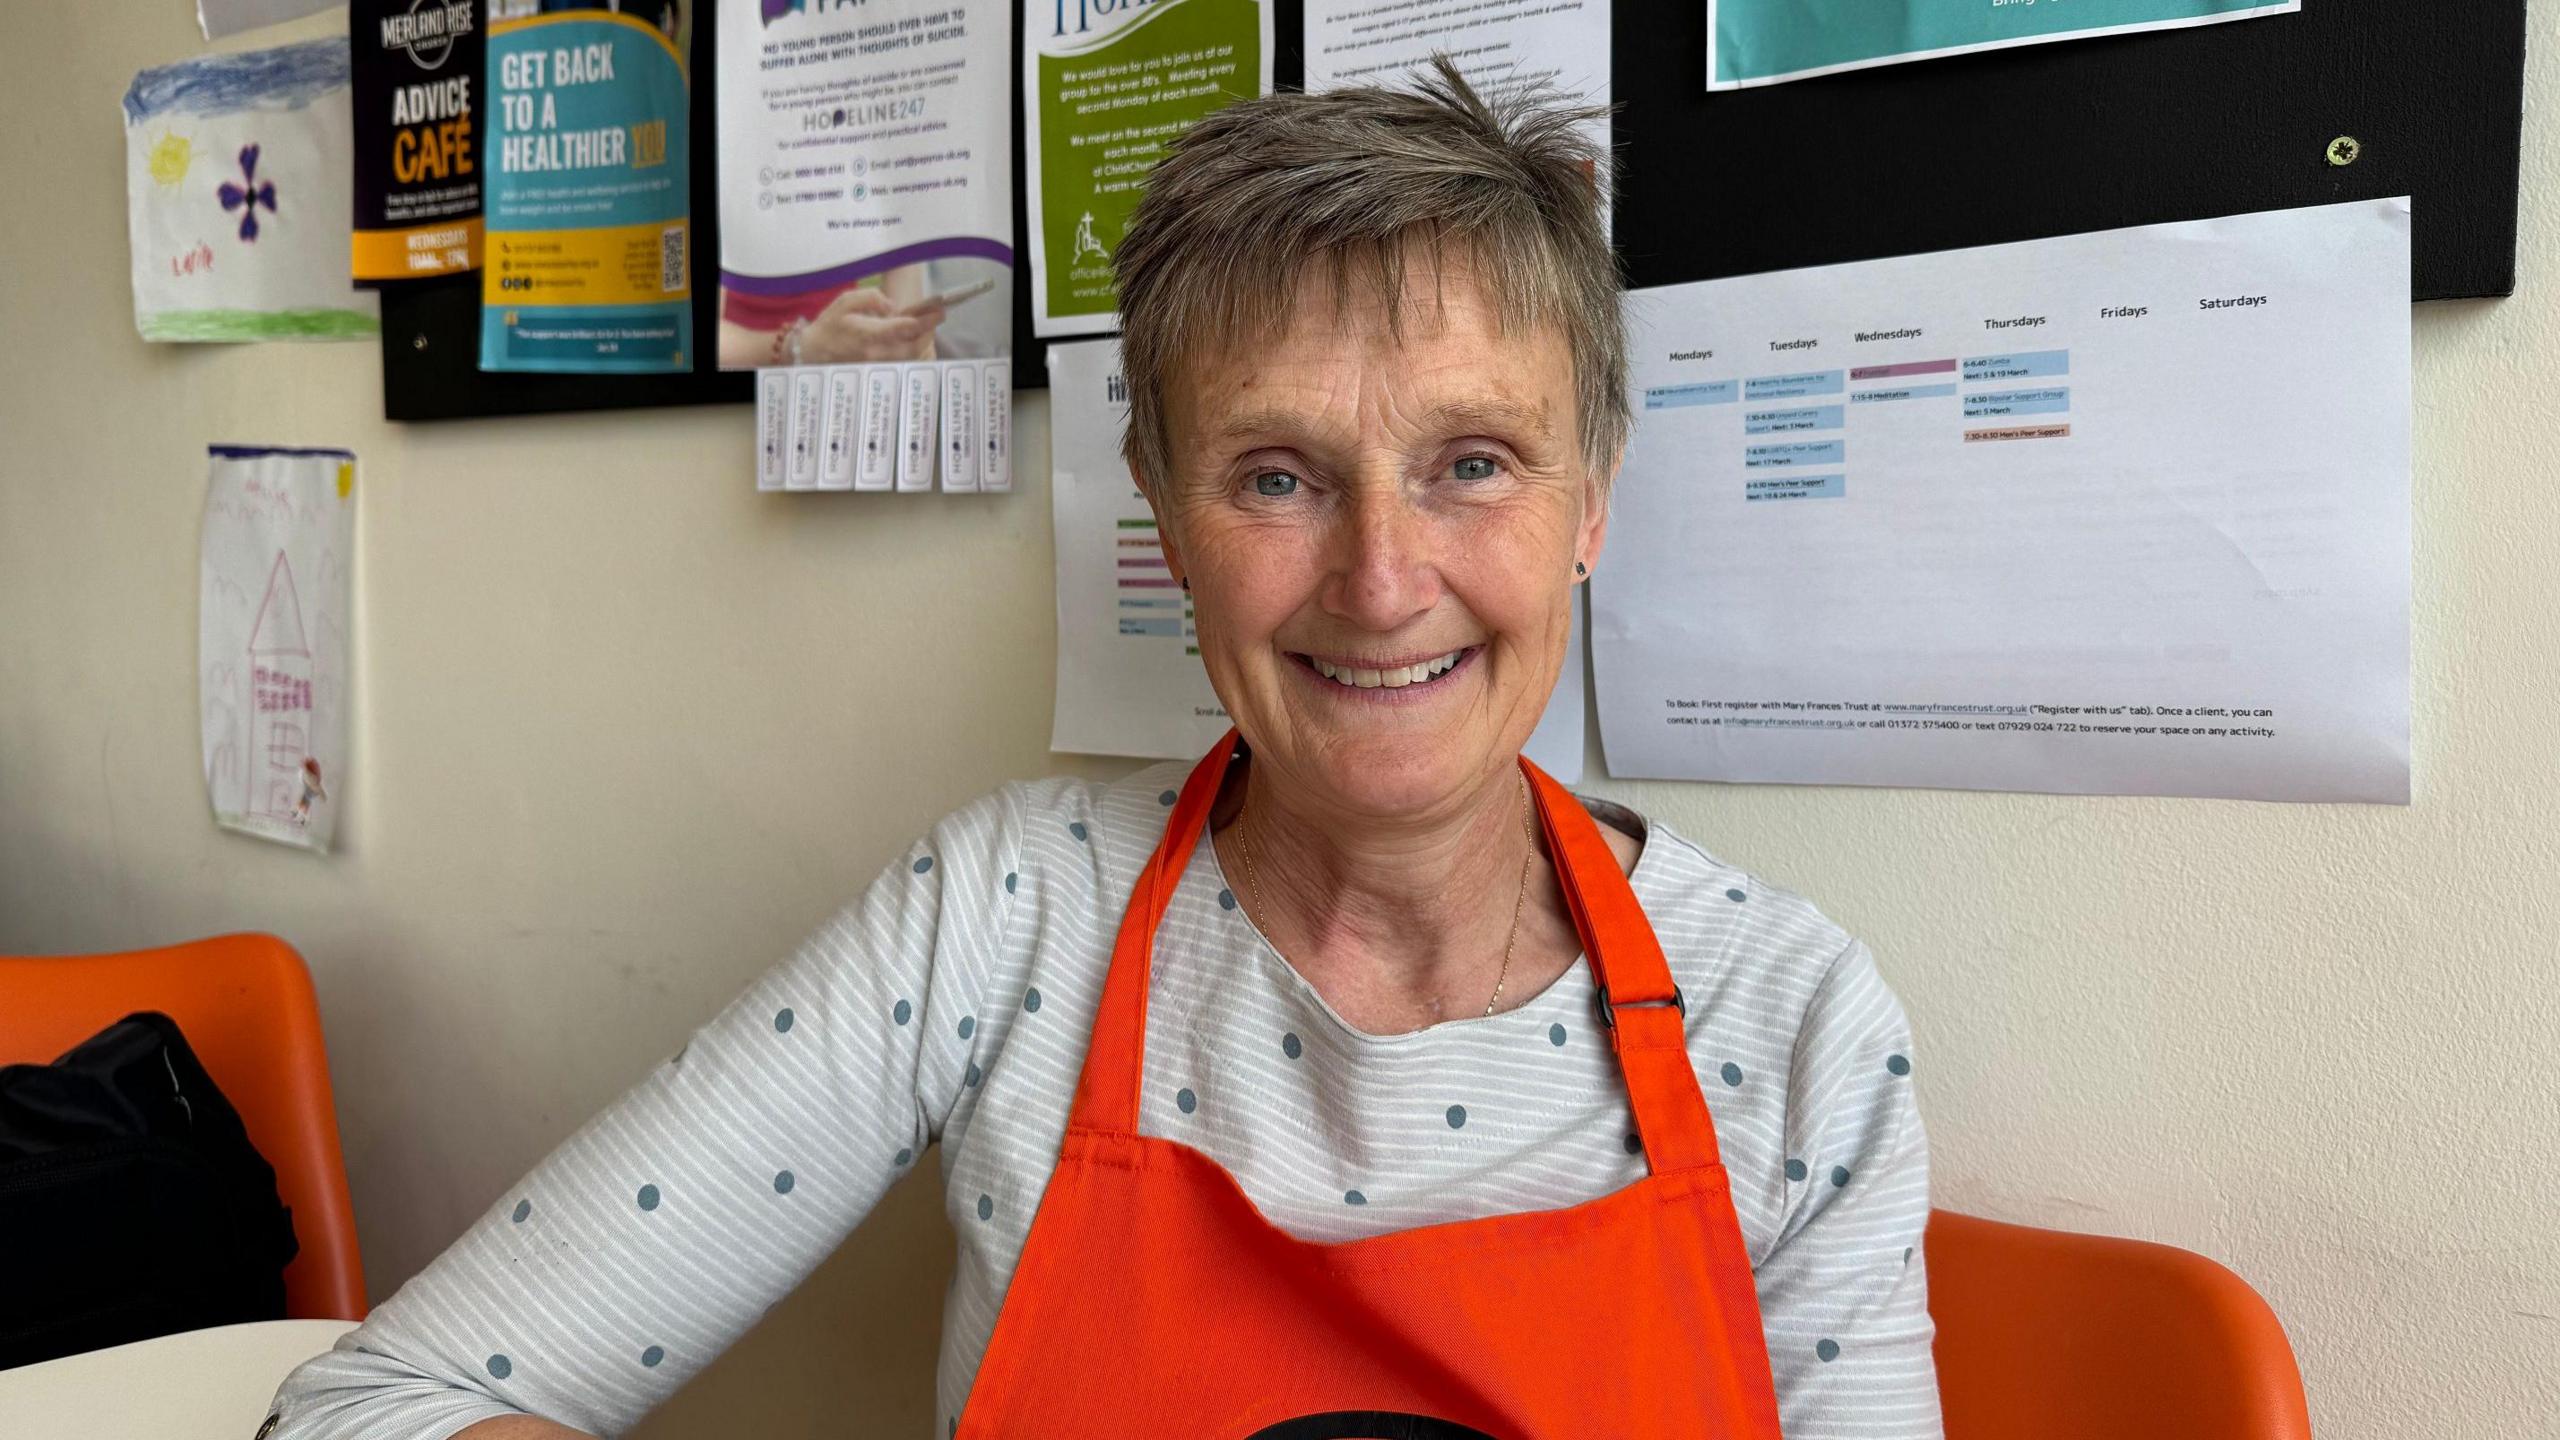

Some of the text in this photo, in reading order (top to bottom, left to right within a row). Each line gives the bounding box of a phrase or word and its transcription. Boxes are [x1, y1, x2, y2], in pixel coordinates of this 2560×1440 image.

[381, 0, 474, 48] MERLAND RISE
[763, 9, 965, 54] NO YOUNG PERSON SHOULD EVER HAVE TO
[760, 26, 968, 71] SUFFER ALONE WITH THOUGHTS OF SUICIDE.
[1062, 72, 1077, 83] We
[1079, 67, 1107, 81] would
[1109, 64, 1128, 76] love
[1130, 61, 1142, 72] for
[1143, 59, 1161, 72] you
[1162, 55, 1173, 66] to
[1173, 51, 1191, 67] join
[1193, 51, 1204, 61] us
[1217, 45, 1233, 57] our
[501, 42, 615, 90] GET BACK
[1060, 87, 1088, 102] group
[1090, 84, 1102, 95] for
[1103, 81, 1118, 93] the
[1119, 79, 1140, 91] over
[1168, 67, 1207, 83] Meeting
[1209, 62, 1237, 77] every
[392, 75, 472, 126] ADVICE
[501, 92, 557, 132] TO A
[1076, 81, 1220, 114] second Monday of each month
[803, 97, 926, 133] HOPELINE247
[1142, 121, 1178, 137] second
[392, 111, 474, 184] CAFÉ
[502, 120, 667, 173] HEALTHIER YOU
[1669, 295, 2267, 362] Mondays Tuesdays Wednesdays Thursdays Fridays Saturdays
[1963, 372, 1982, 380] Next:
[2007, 368, 2028, 376] March
[1874, 391, 1910, 400] Meditation
[1990, 406, 2010, 415] March
[2013, 390, 2065, 401] Support Group
[1795, 421, 1814, 430] March
[2037, 428, 2065, 437] Support
[1772, 458, 1791, 466] March
[1800, 479, 1825, 488] Support
[1666, 700, 1675, 708] To
[1677, 700, 1698, 708] Book:
[1701, 701, 1722, 709] First
[1724, 702, 1758, 711] register
[1761, 702, 1781, 710] with
[1783, 702, 1804, 712] Mary
[1807, 702, 1841, 711] Frances
[1844, 702, 1869, 711] Trust
[1871, 703, 1881, 711] at
[1884, 703, 2027, 714] www.maryfrancestrust.org.uk
[2029, 704, 2080, 716] ("Register
[2083, 705, 2107, 715] with
[2129, 706, 2154, 717] tab).
[2156, 706, 2183, 716] Once
[2185, 708, 2192, 716] a
[2194, 706, 2229, 718] client,
[2231, 709, 2251, 719] you
[2253, 708, 2273, 717] can
[1666, 717, 2276, 738] contact us at info@maryfrancestrust.org.uk or call 01372 375400 or text 07929 024 722 to reserve your space on any activity.
